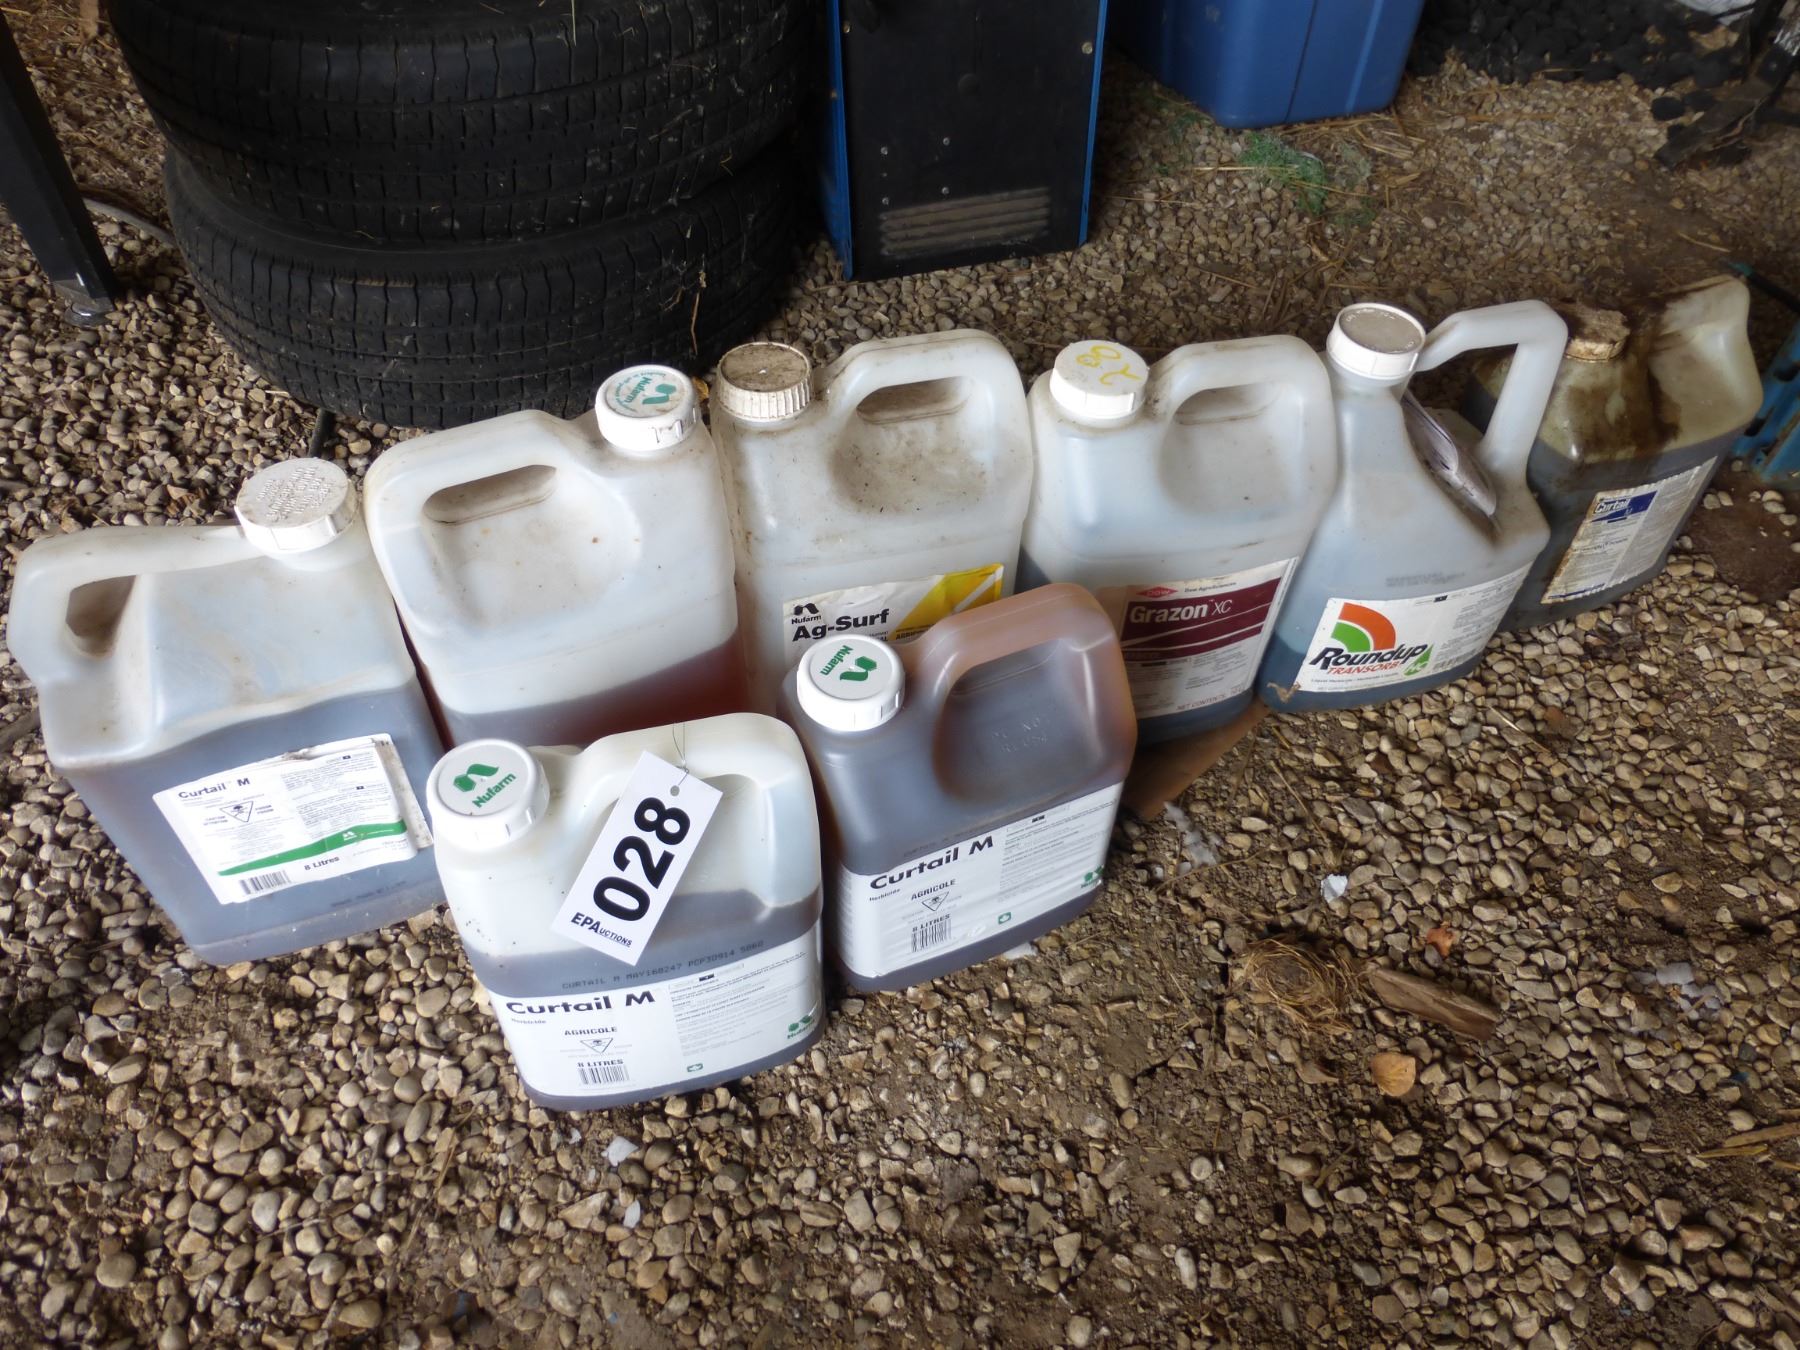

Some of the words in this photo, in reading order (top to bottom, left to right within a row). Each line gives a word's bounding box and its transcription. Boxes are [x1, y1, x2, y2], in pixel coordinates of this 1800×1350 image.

[624, 376, 652, 403] Nufarm
[791, 614, 822, 625] Nufarm
[1130, 603, 1209, 624] Grazon
[1211, 599, 1233, 616] XC
[792, 608, 890, 642] Ag-Surf
[820, 644, 854, 676] Nufarm
[1309, 643, 1428, 670] Roundup
[1326, 661, 1401, 675] TRANSORB
[178, 782, 227, 799] Curtail
[236, 778, 250, 787] M
[471, 773, 517, 809] Nufarm
[313, 856, 340, 869] Litres
[593, 796, 691, 922] 028
[870, 846, 959, 890] Curtail
[968, 835, 994, 856] M
[911, 879, 957, 901] AGRICOLE
[920, 913, 951, 930] LITRES
[562, 978, 606, 990] CURTAIL
[506, 995, 612, 1015] Curtail
[625, 990, 656, 1007] M
[564, 1026, 618, 1036] AGRICOLE
[587, 1058, 624, 1067] LITRES
